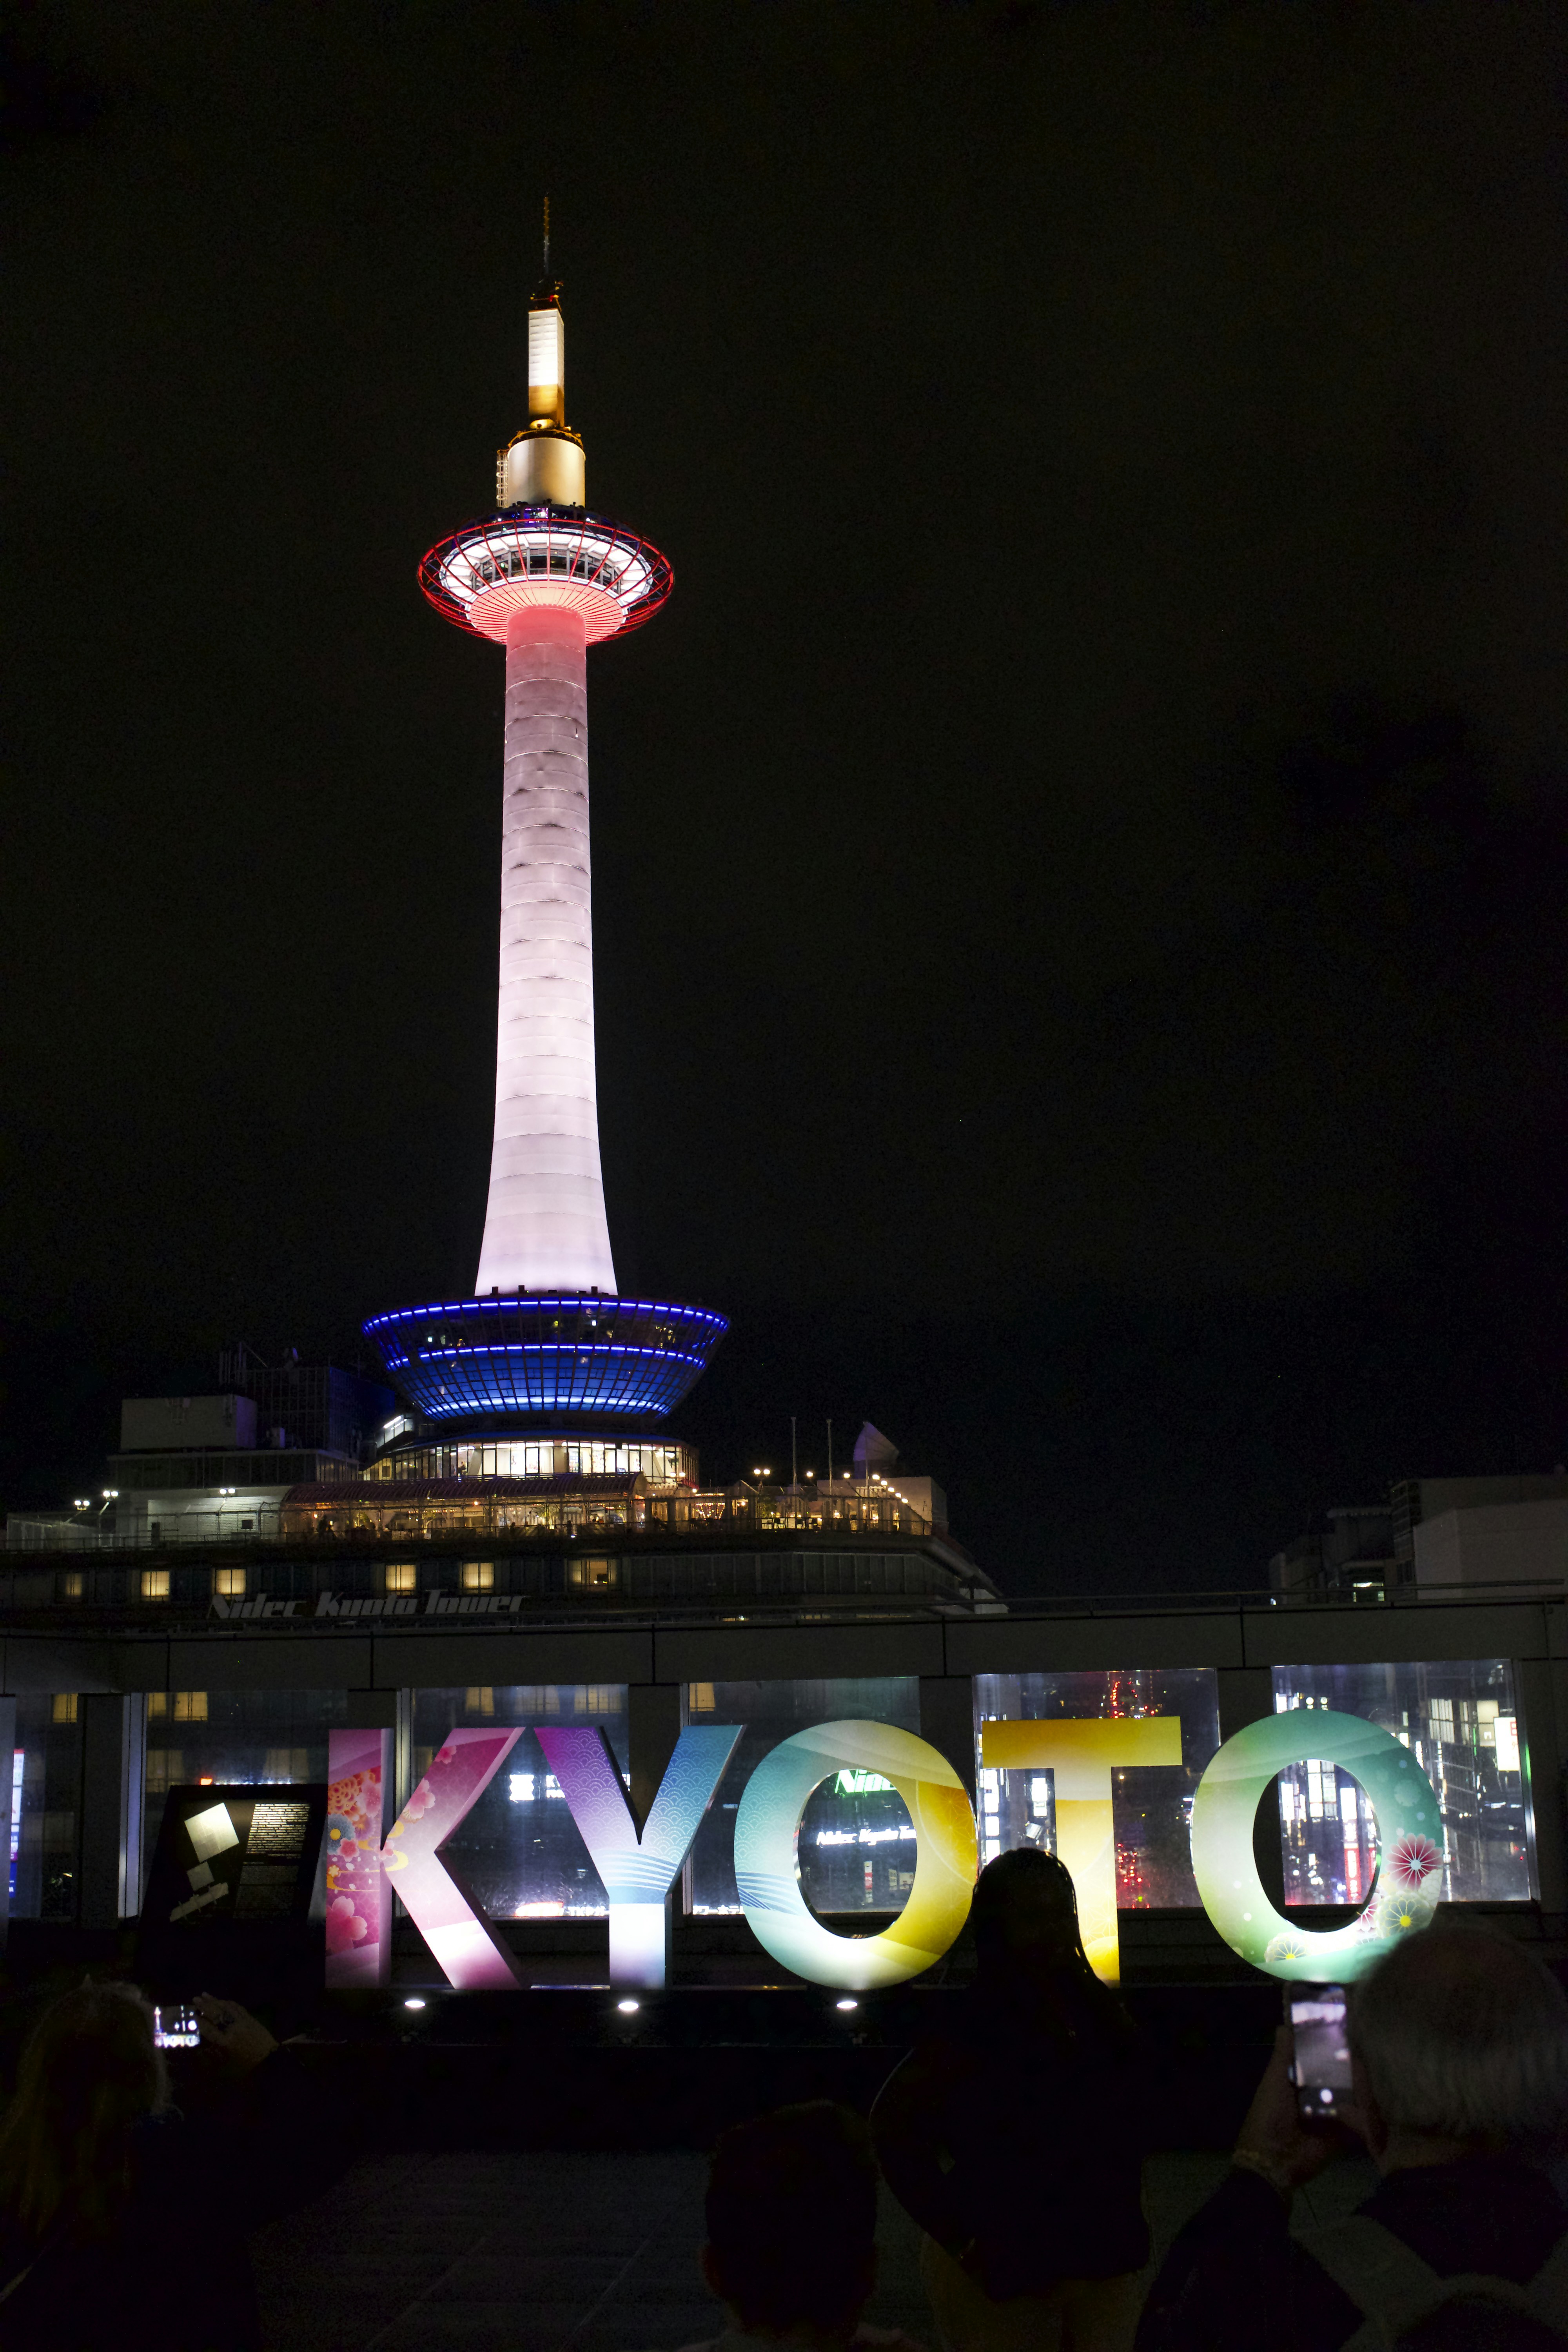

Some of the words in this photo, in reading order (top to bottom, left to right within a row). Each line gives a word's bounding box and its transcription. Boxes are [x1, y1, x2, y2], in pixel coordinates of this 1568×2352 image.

[207, 1592, 307, 1619] Nidec
[314, 1591, 418, 1624] Kyoto
[425, 1589, 532, 1614] Tower
[325, 1709, 1444, 1991] KYOTO
